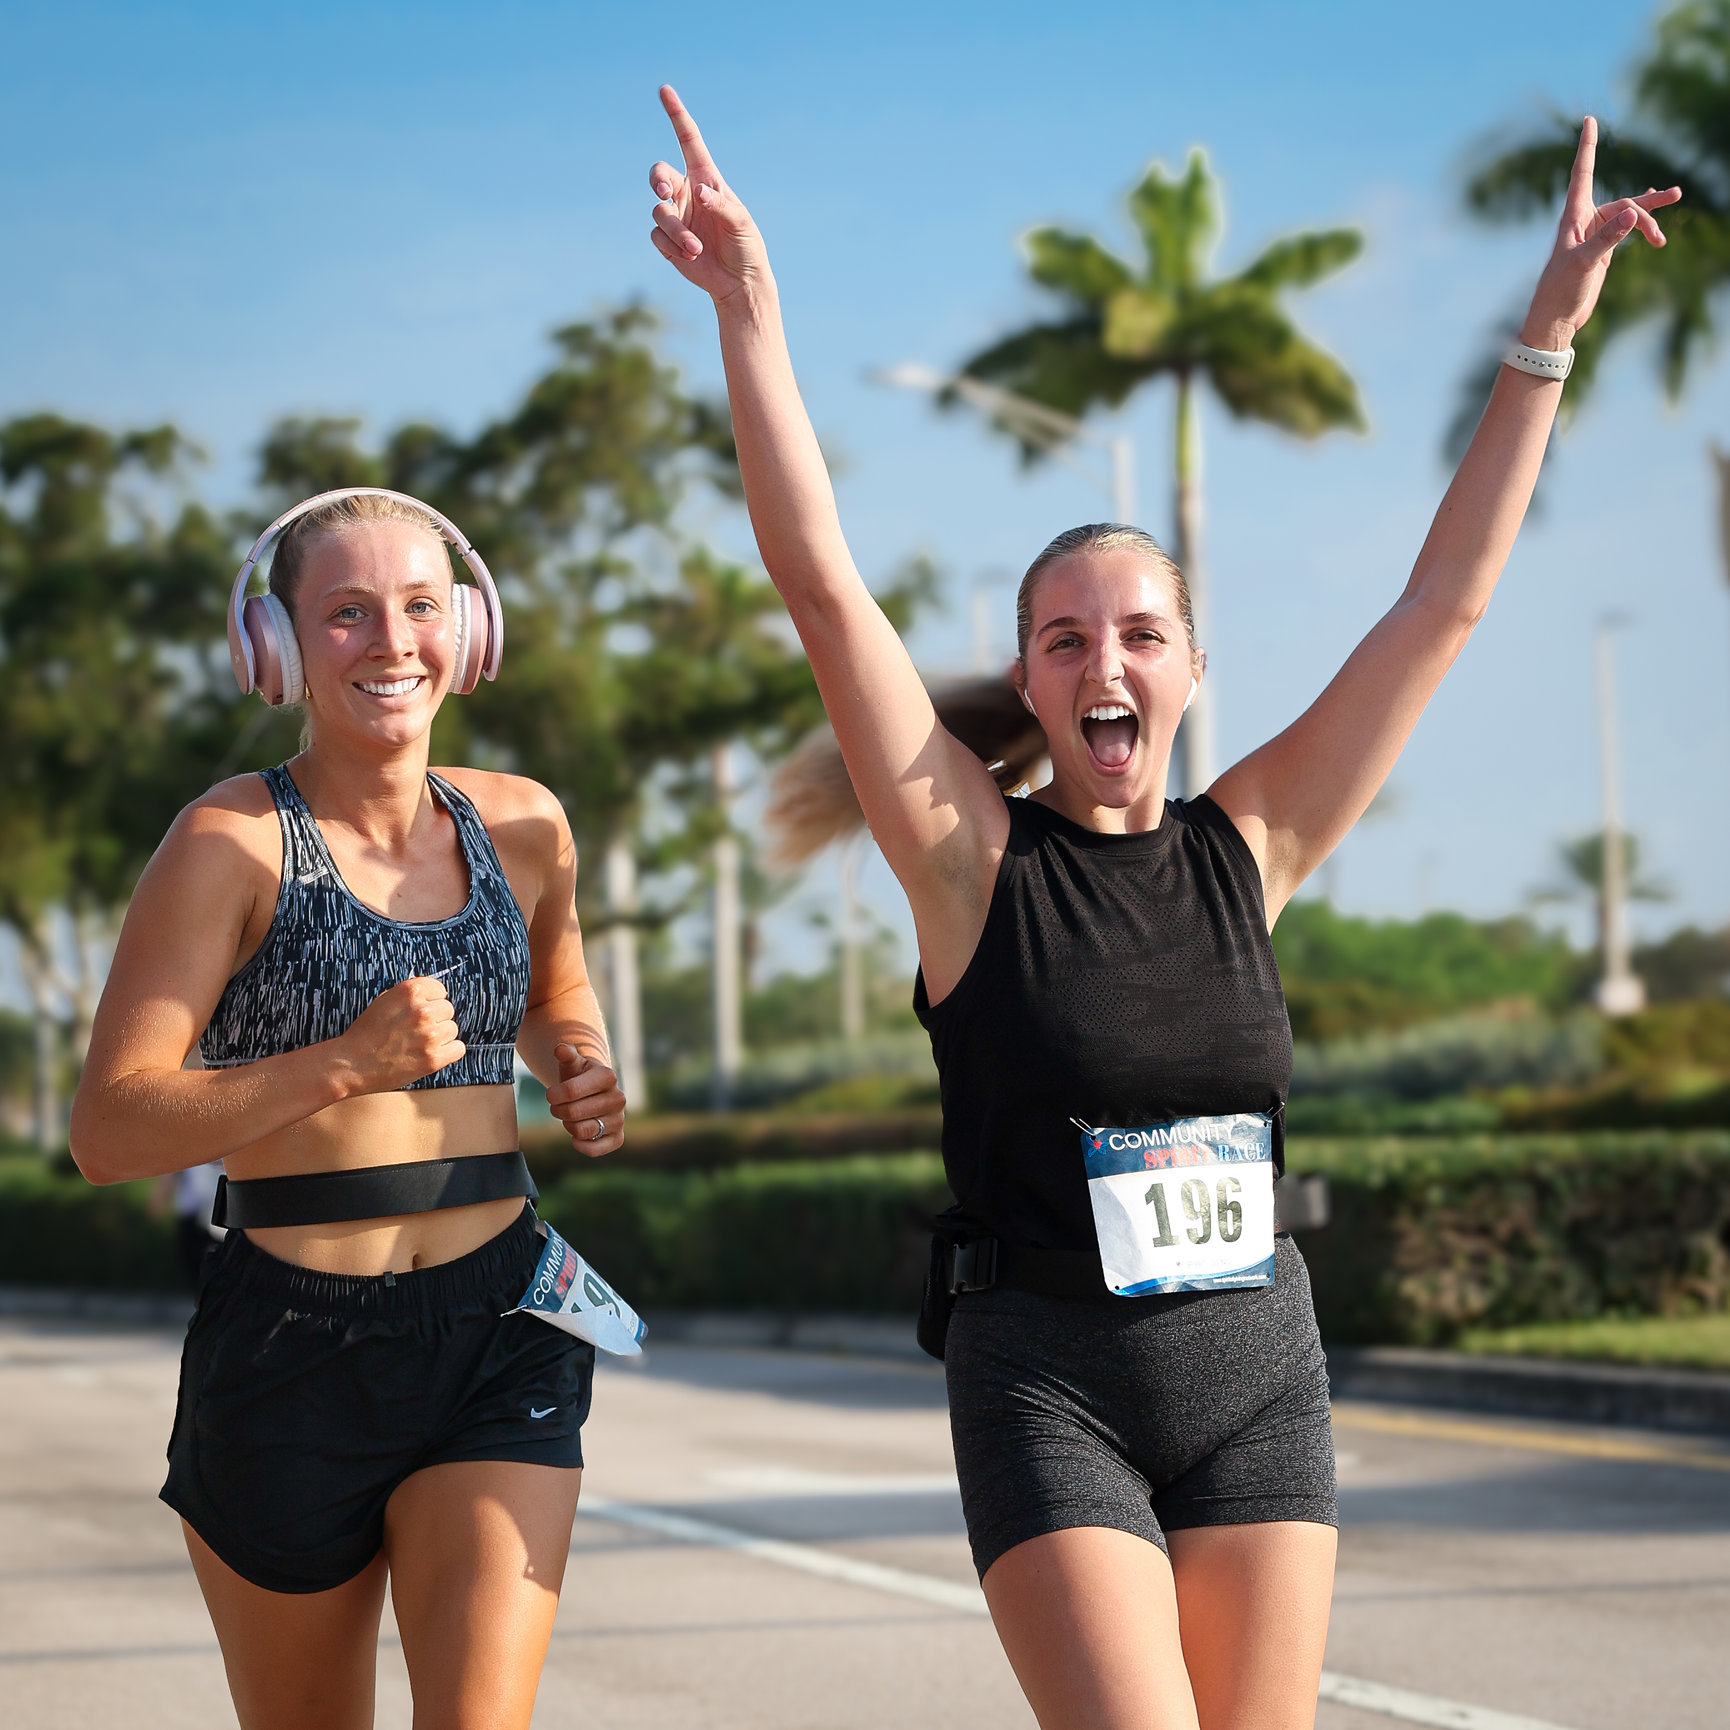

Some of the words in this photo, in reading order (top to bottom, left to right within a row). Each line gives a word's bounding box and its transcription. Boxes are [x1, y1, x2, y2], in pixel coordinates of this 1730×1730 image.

[1108, 1123, 1235, 1151] COMMUNITY
[1143, 1144, 1211, 1169] SPIRIT
[1217, 1142, 1266, 1162] RACE
[1144, 1176, 1243, 1248] 196
